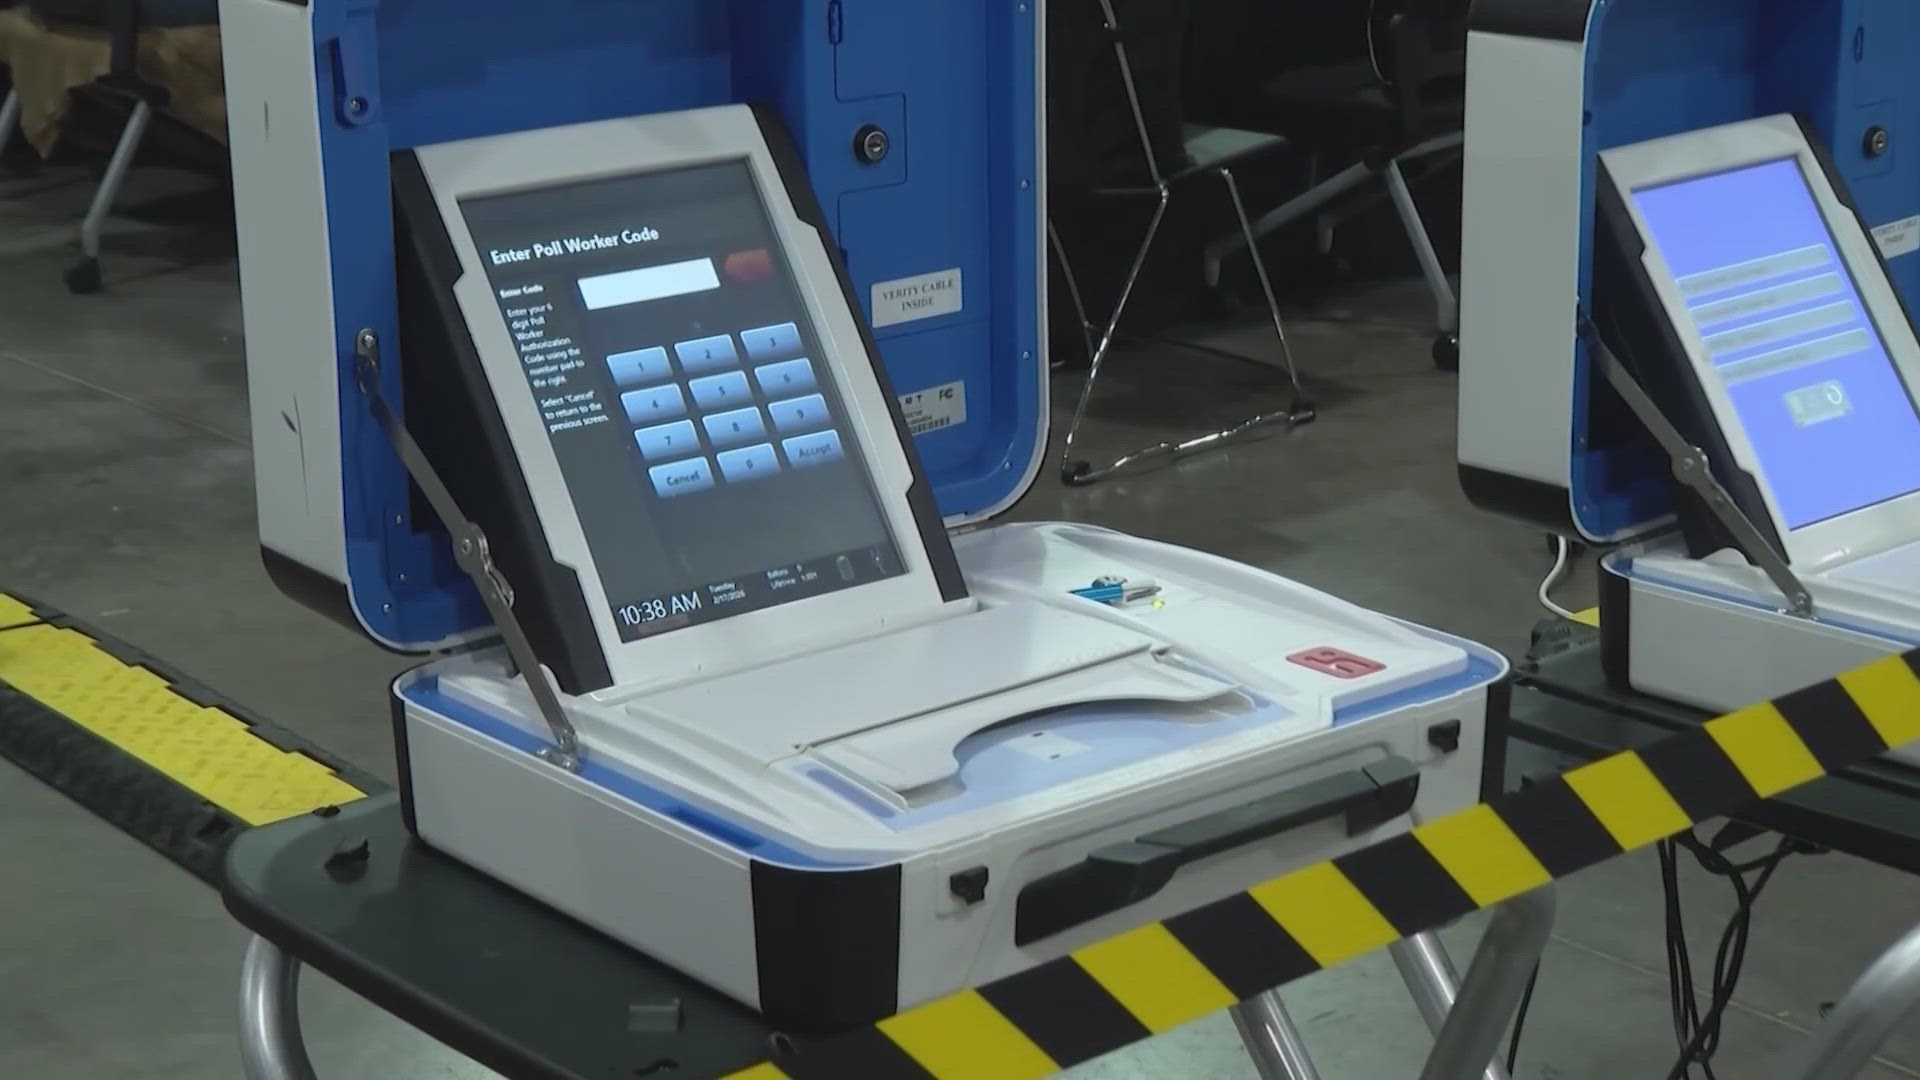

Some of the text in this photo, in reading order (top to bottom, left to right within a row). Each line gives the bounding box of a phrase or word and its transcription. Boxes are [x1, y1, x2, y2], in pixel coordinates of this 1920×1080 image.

[490, 227, 659, 265] Enter Poll Worker Code
[499, 284, 544, 298] Enter Code
[882, 278, 955, 300] VERITY CABLE
[506, 308, 527, 318] Enter
[528, 304, 546, 316] your
[901, 296, 935, 311] INSIDE
[511, 316, 546, 330] digit Poll
[515, 330, 544, 341] Worker
[520, 337, 572, 352] Authorization
[705, 350, 711, 359] 2
[769, 337, 777, 347] 3
[524, 348, 580, 364] Code using the
[529, 359, 585, 376] number pad to
[532, 379, 547, 388] the
[784, 373, 791, 384] 6
[540, 396, 564, 408] Select
[545, 402, 602, 419] to return to the
[549, 419, 583, 434] previous
[664, 409, 804, 445] 7 8 9
[666, 470, 701, 486] Cancel
[798, 443, 832, 458] Accept
[708, 582, 736, 593] Tuesday
[618, 591, 702, 626] 10:38 AM
